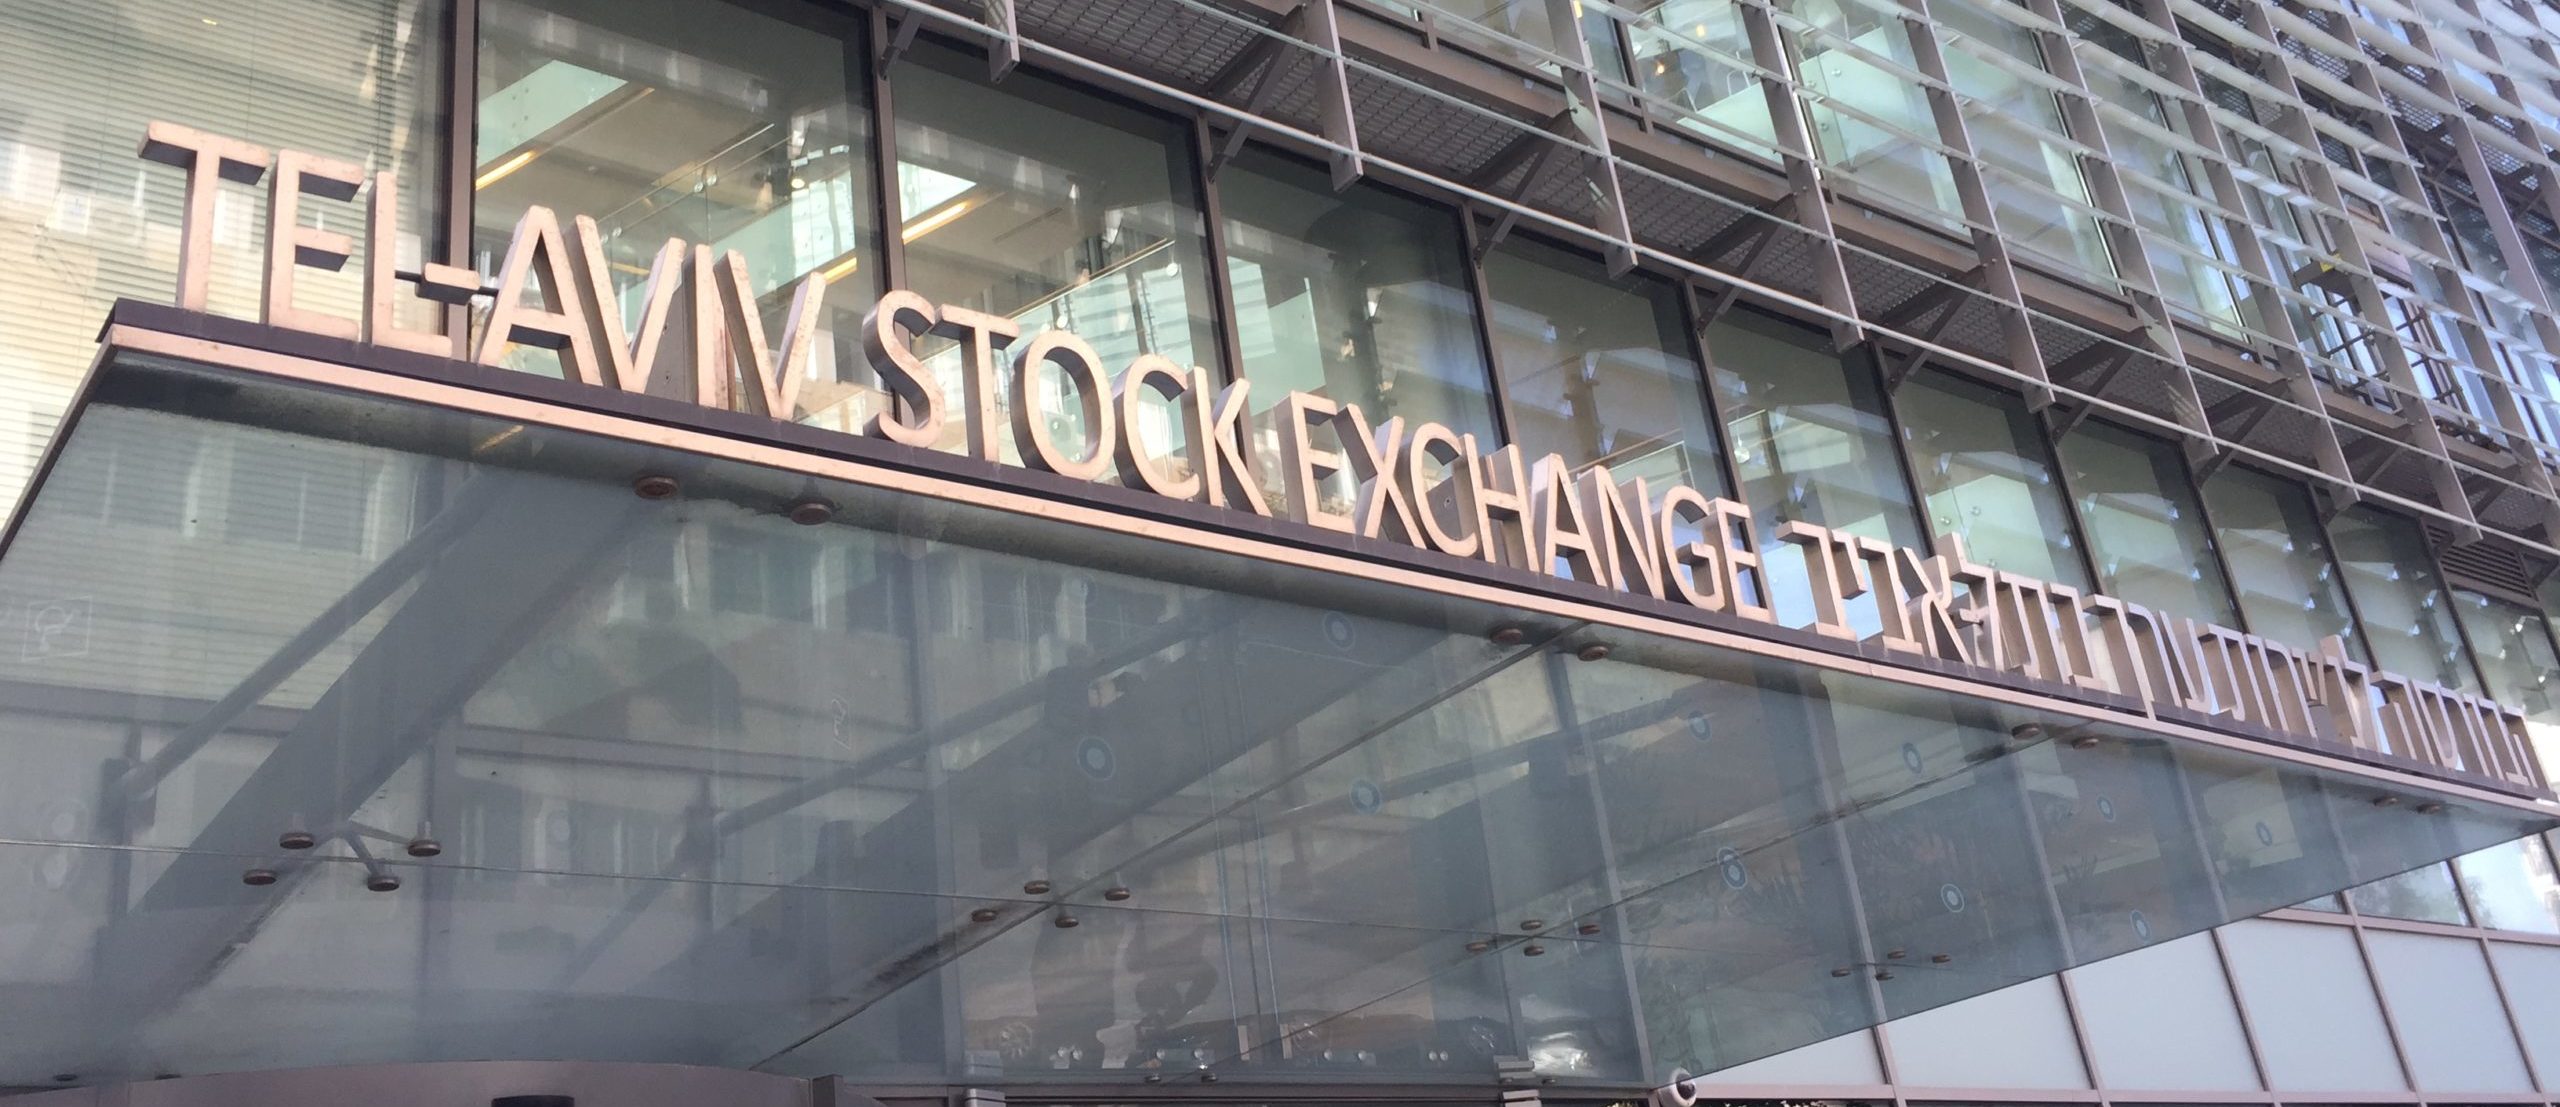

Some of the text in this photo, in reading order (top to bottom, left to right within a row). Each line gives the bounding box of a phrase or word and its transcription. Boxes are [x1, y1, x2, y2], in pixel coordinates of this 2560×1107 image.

[138, 121, 1777, 625] TEL-AVIV STOCK EXCHANGE
[2083, 594, 2217, 720] ערך
